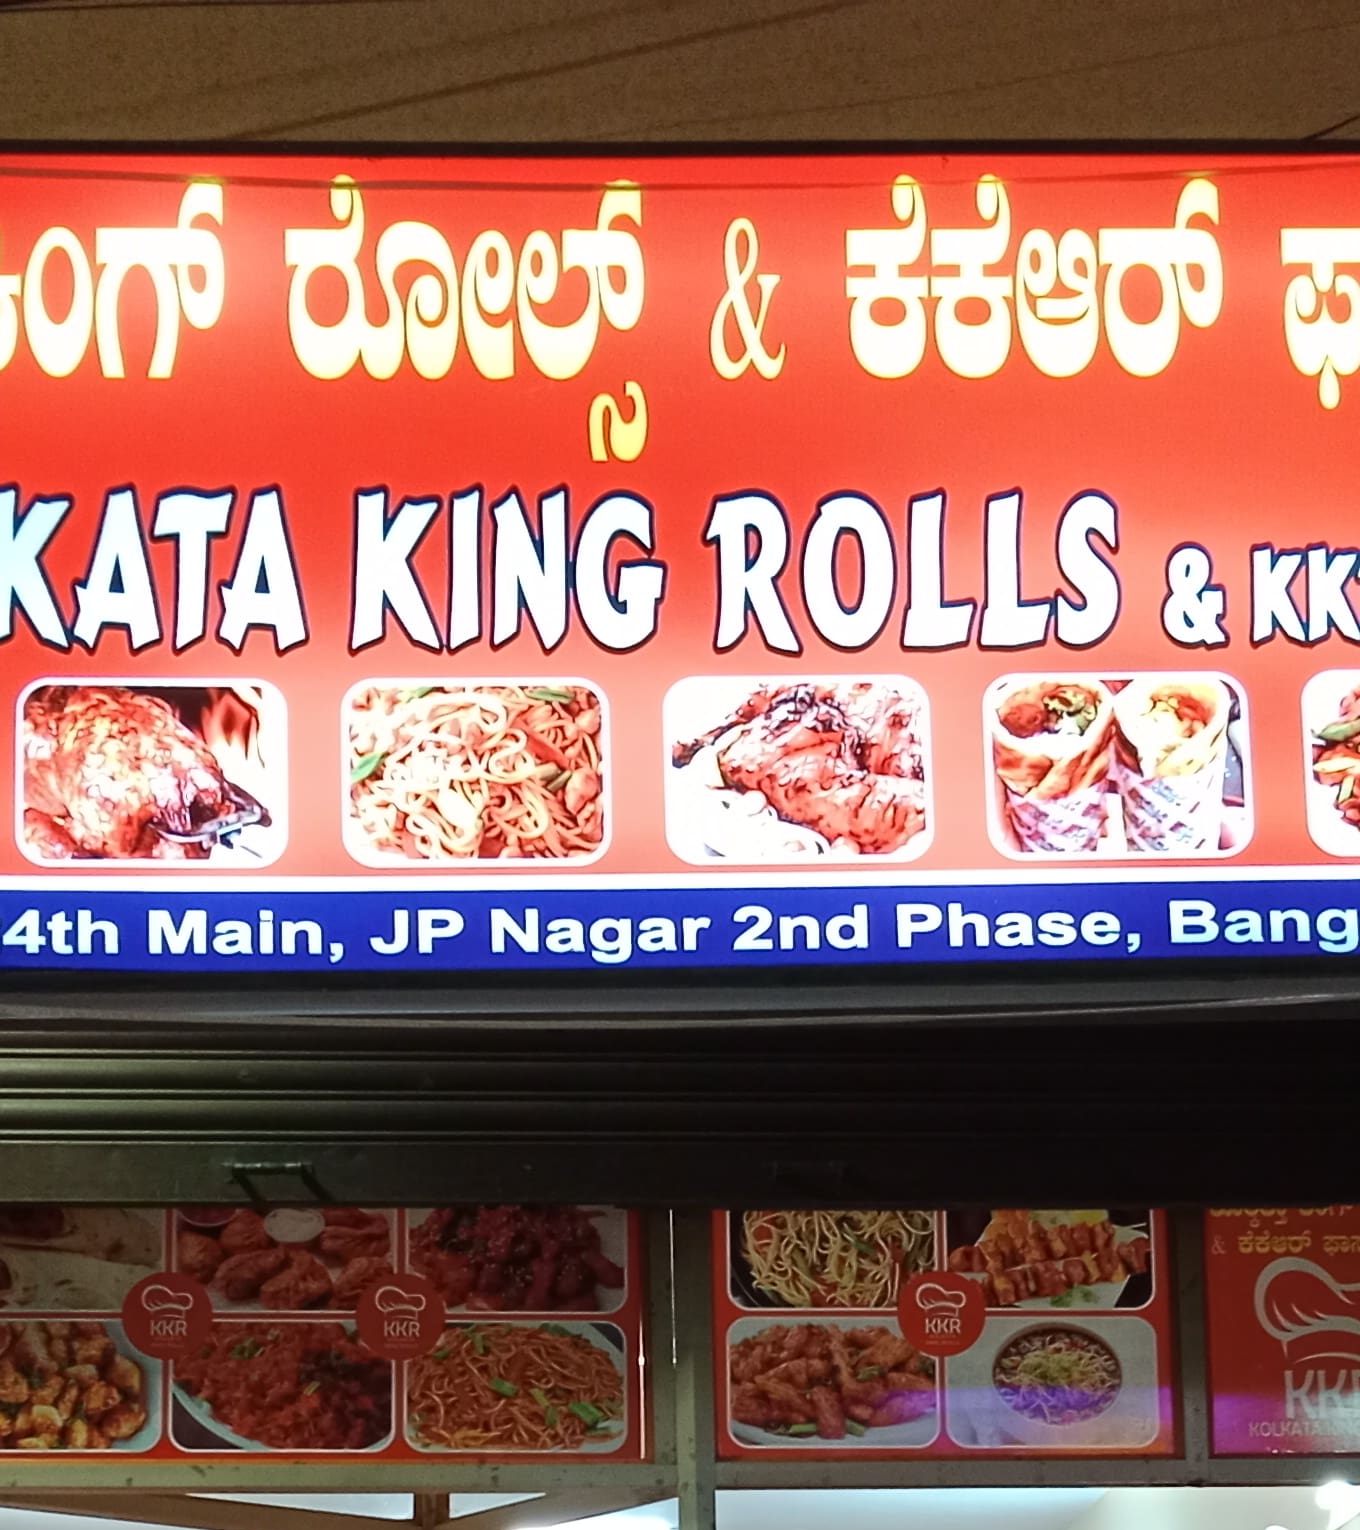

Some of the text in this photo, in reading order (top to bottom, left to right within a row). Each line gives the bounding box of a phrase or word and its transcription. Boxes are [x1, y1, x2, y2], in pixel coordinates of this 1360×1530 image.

[285, 175, 647, 462] ರೋಲ್ಸ್
[710, 218, 786, 379] &
[846, 175, 1223, 378] ಕೆಕೆಆರ್
[349, 486, 663, 654] KING
[706, 489, 1120, 656] ROLLS
[1165, 543, 1226, 647] &
[148, 907, 345, 961] Main,
[370, 907, 466, 954] JP
[490, 908, 710, 964] Nagar
[733, 904, 885, 953] 2nd
[894, 901, 1141, 955] Phase,
[1212, 1236, 1225, 1253] &
[150, 1320, 187, 1336] KKR
[384, 1321, 419, 1337] KKR
[924, 1318, 962, 1333] KKR
